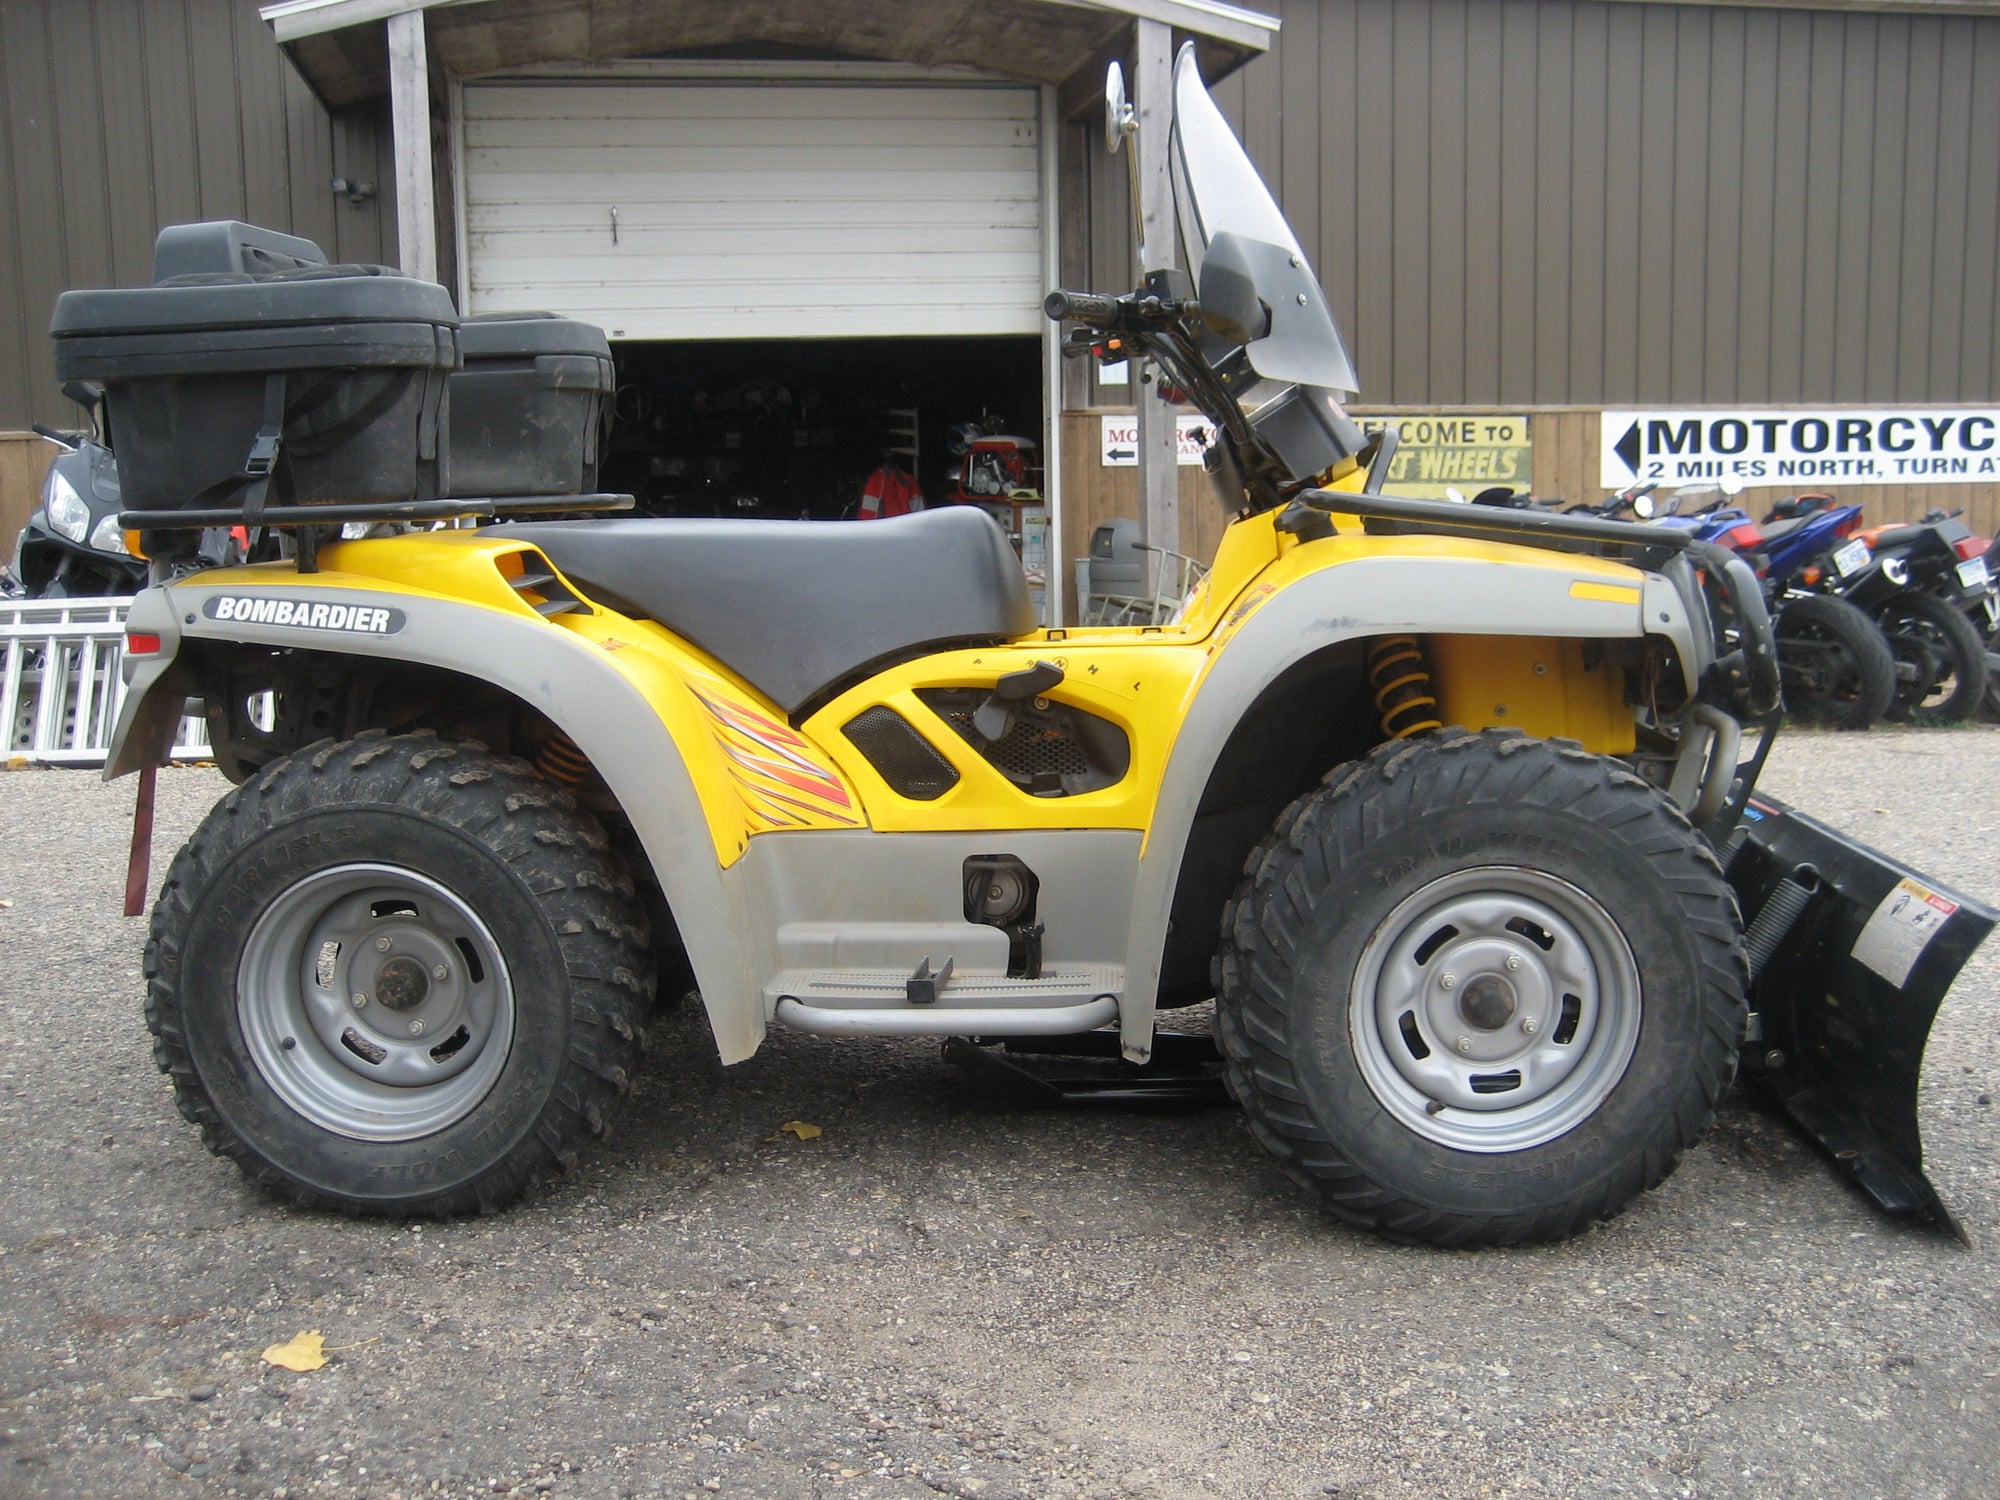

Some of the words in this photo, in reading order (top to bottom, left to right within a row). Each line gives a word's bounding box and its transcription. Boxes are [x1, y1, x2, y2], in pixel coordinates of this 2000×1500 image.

[1485, 426, 1513, 441] TO
[1419, 448, 1518, 480] WHEELS
[1648, 461, 1665, 478] 2
[1677, 459, 1767, 478] MILES
[1778, 458, 1883, 478] NORTH,
[1894, 457, 1968, 475] TURN
[215, 597, 391, 633] BOMBARDIER
[1087, 664, 1099, 675] H
